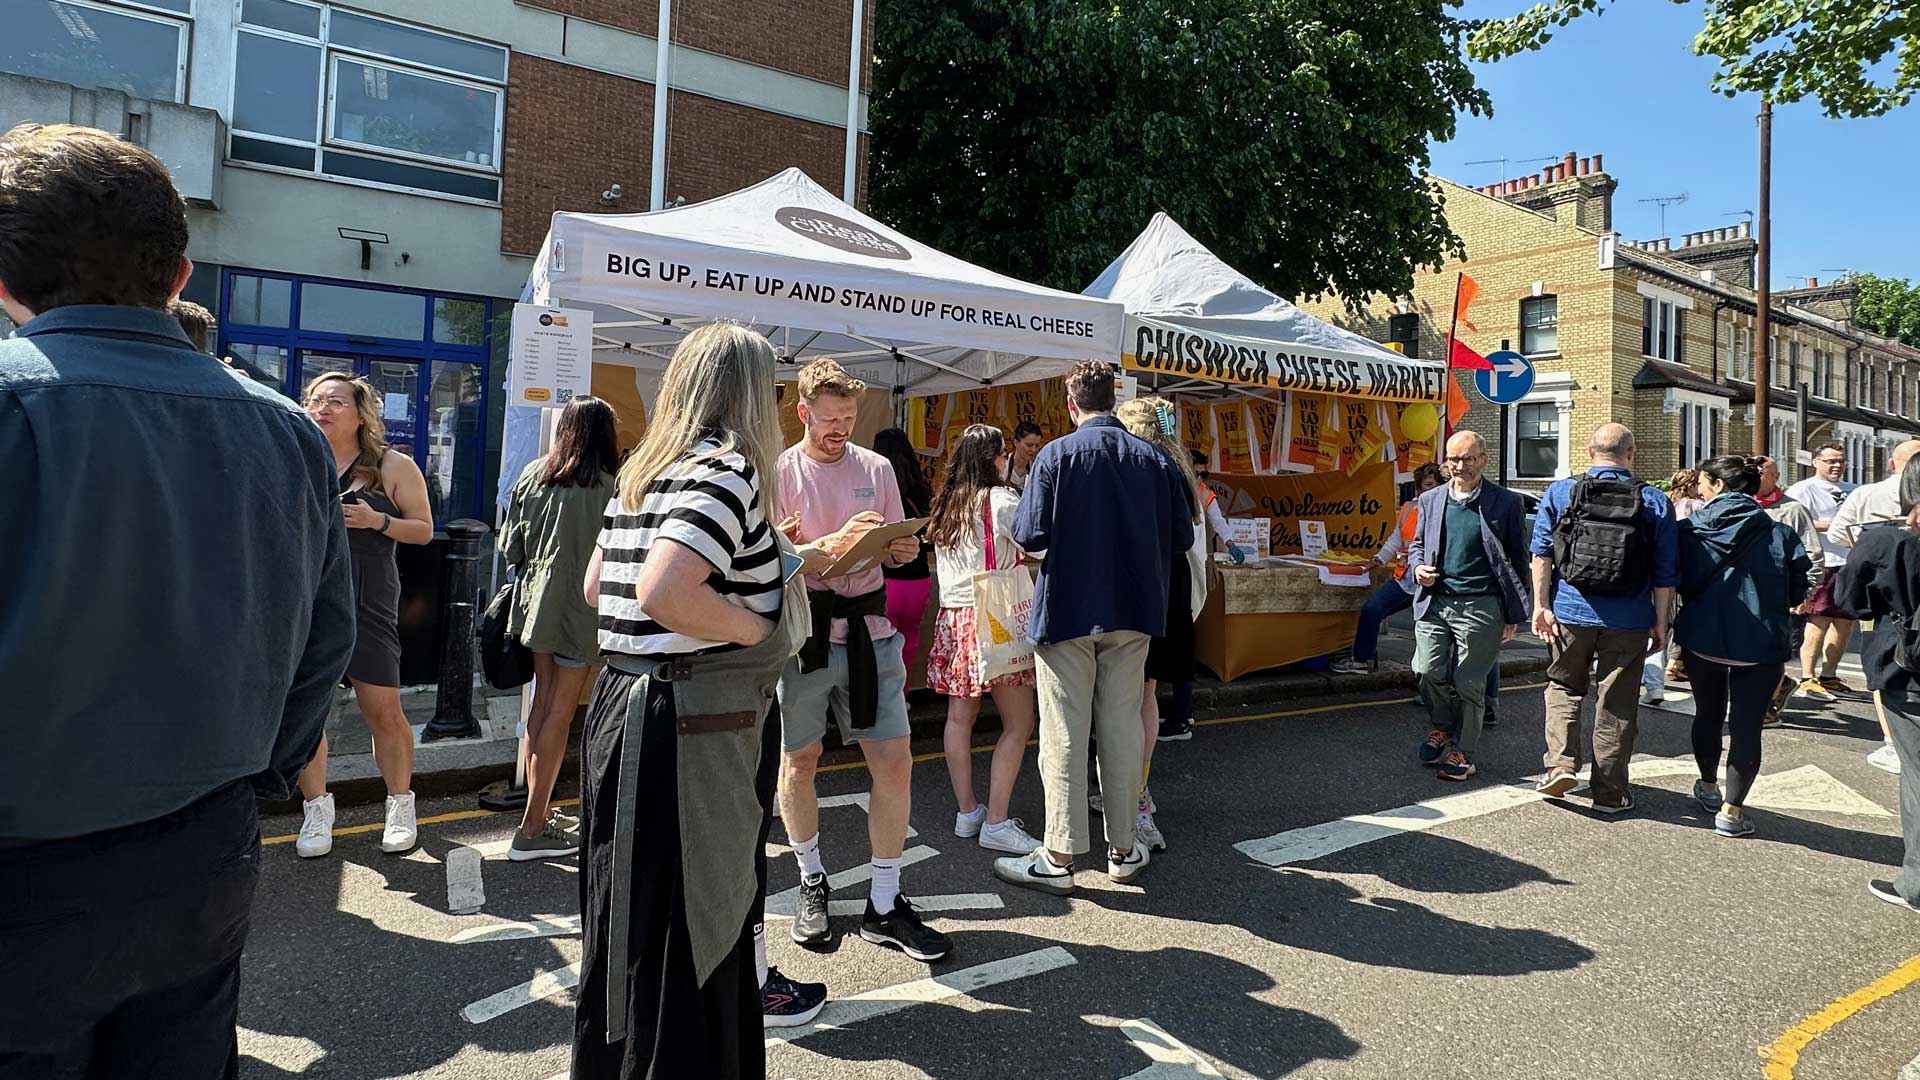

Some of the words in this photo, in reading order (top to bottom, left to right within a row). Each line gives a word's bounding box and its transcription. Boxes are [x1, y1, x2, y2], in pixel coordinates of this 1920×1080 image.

[607, 253, 651, 278] BIG
[659, 261, 698, 288] UP,
[705, 269, 749, 292] EAT
[755, 276, 784, 297] UP
[787, 281, 836, 305] AND
[840, 288, 906, 314] STAND
[911, 299, 936, 318] UP
[940, 304, 978, 324] FOR
[982, 309, 1027, 330] REAL
[1030, 315, 1095, 338] CHEESE
[1135, 326, 1269, 385] CHISWICK
[1275, 352, 1362, 395] CHEESE
[1365, 362, 1446, 401] MARKET
[969, 391, 988, 402] WE
[1014, 391, 1033, 402] WE
[968, 403, 989, 416] LO
[1015, 402, 1036, 415] LO
[1255, 401, 1274, 416] WE
[1299, 399, 1318, 411] WE
[1346, 403, 1366, 415] WE
[1221, 411, 1238, 421] WE
[1300, 411, 1320, 425] LO
[1348, 415, 1368, 430] LO
[1301, 424, 1319, 439] VE
[1261, 493, 1354, 517] Welcome
[1359, 493, 1382, 515] to
